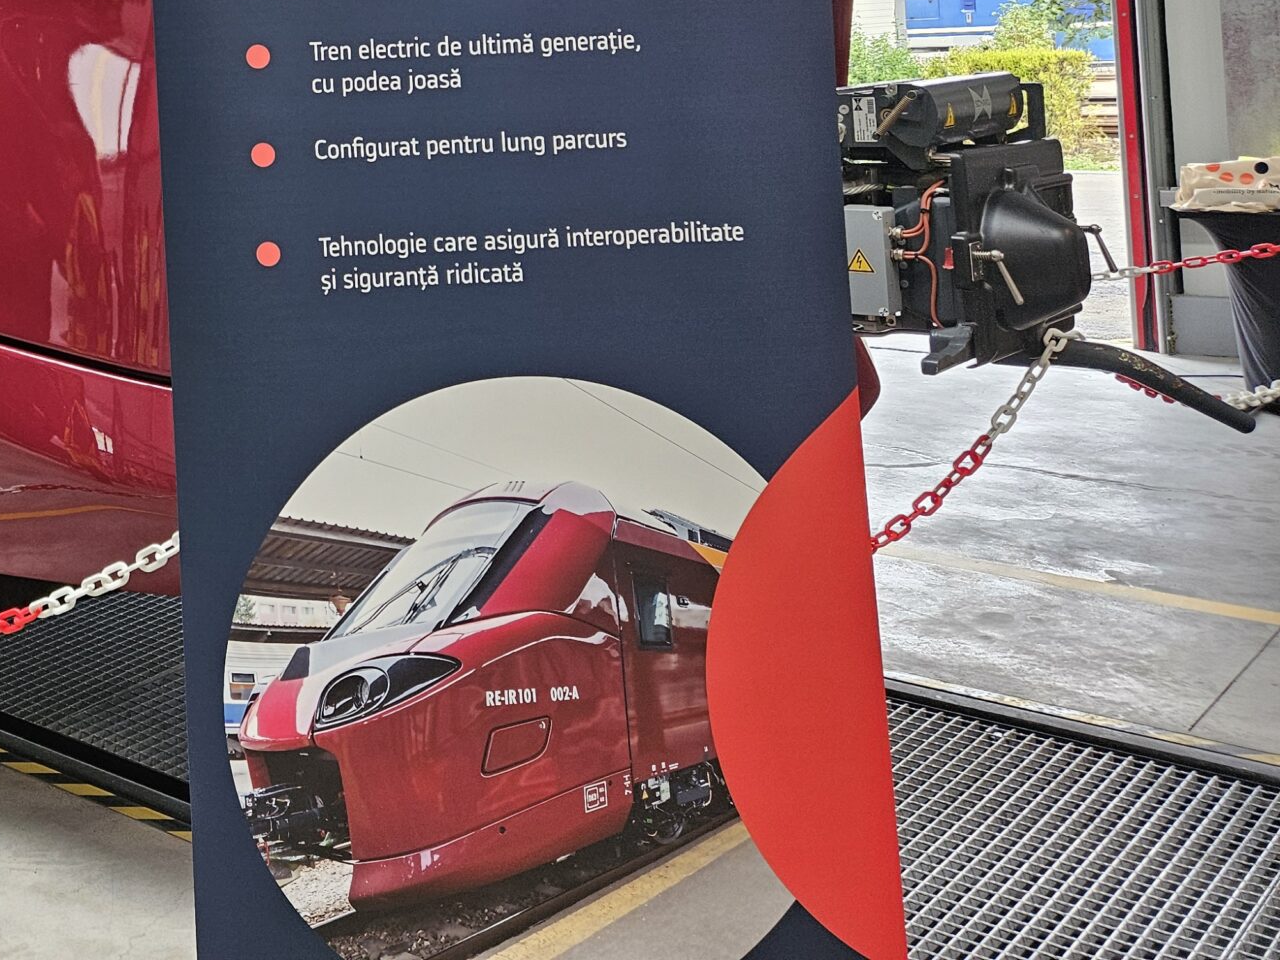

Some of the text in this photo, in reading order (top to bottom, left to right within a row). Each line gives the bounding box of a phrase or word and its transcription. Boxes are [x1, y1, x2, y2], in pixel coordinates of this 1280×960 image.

[309, 29, 640, 61] Tren electric de ultimă generație,
[312, 69, 461, 97] cu podea joasă
[315, 131, 626, 162] Configurat pentru lung parcurs
[319, 221, 743, 258] Tehnologie care asigură interoperabilitate
[321, 262, 523, 295] și siguranță ridicată
[551, 686, 579, 701] 002-A
